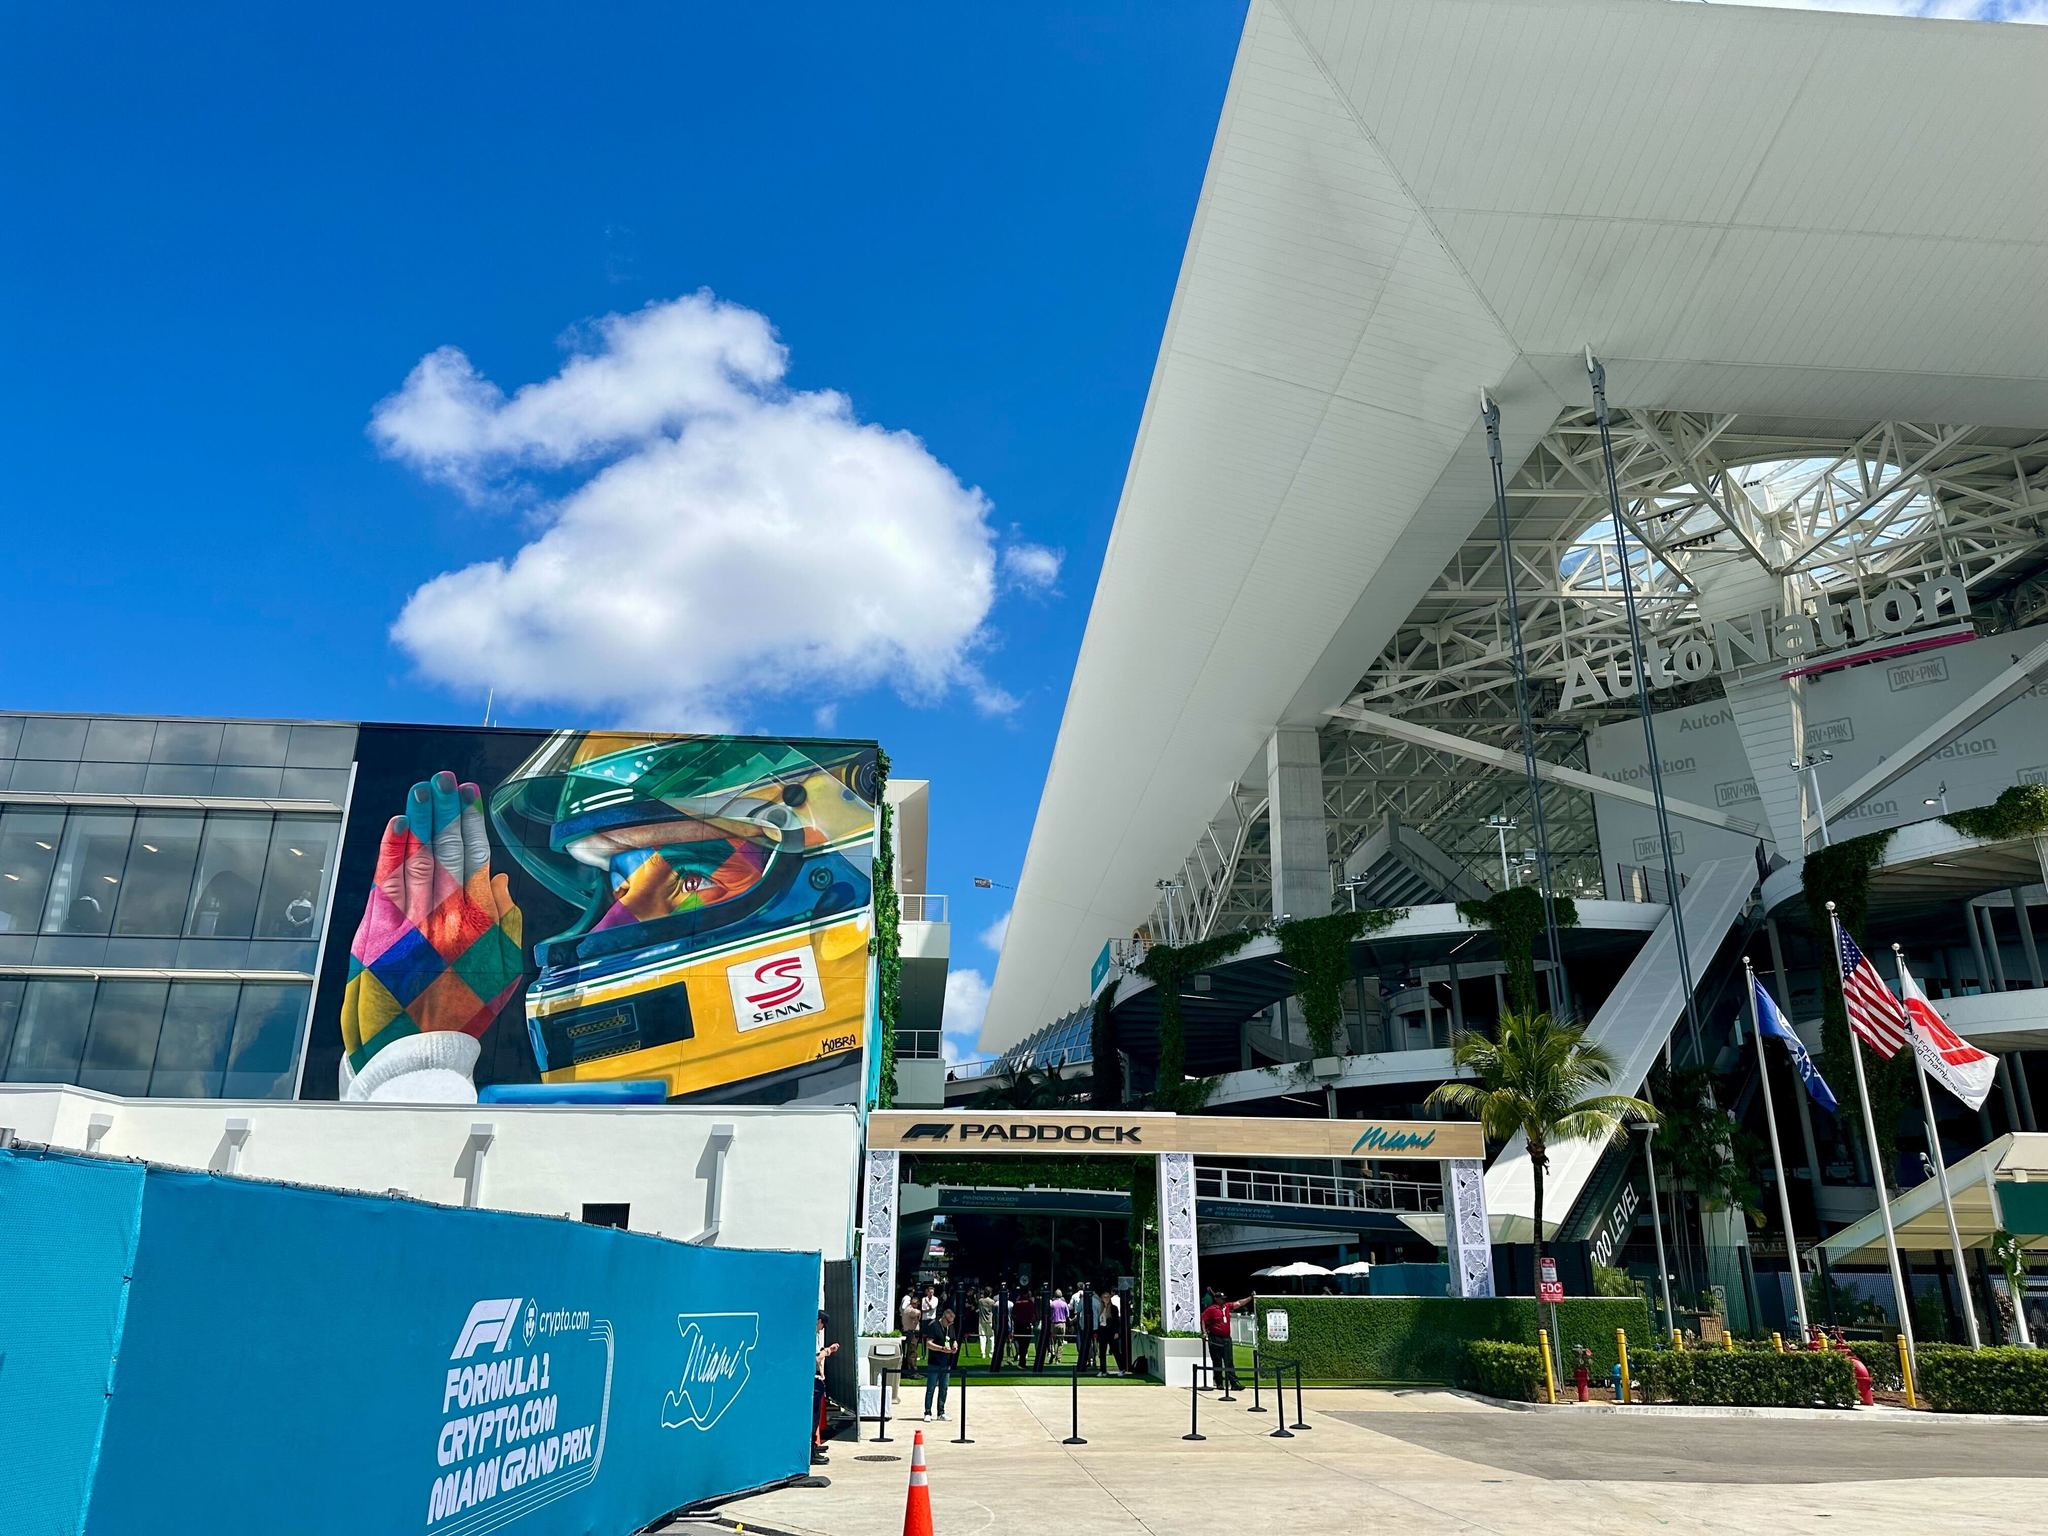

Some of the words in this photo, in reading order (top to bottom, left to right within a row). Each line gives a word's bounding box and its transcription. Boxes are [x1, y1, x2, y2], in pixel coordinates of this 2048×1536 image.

[1558, 575, 1972, 713] AutoNation
[1680, 708, 1734, 732] AutoN
[1602, 757, 1695, 782] AutoNtion
[753, 1002, 813, 1023] SENNA
[821, 1033, 856, 1051] KOBRA
[959, 1124, 1142, 1144] PADDOCK
[1352, 1126, 1436, 1153] Miami
[1609, 1182, 1639, 1244] LEVEL
[1540, 1283, 1562, 1294] FDC
[538, 1308, 590, 1336] crypto.com
[679, 1339, 745, 1393] Miami
[442, 1357, 538, 1413] FORMULA
[538, 1352, 550, 1390] 1
[437, 1394, 558, 1467] CRYPTO.COM
[427, 1456, 501, 1526] MIAMI
[501, 1436, 560, 1492] GRAND
[560, 1424, 595, 1470] PRIX
